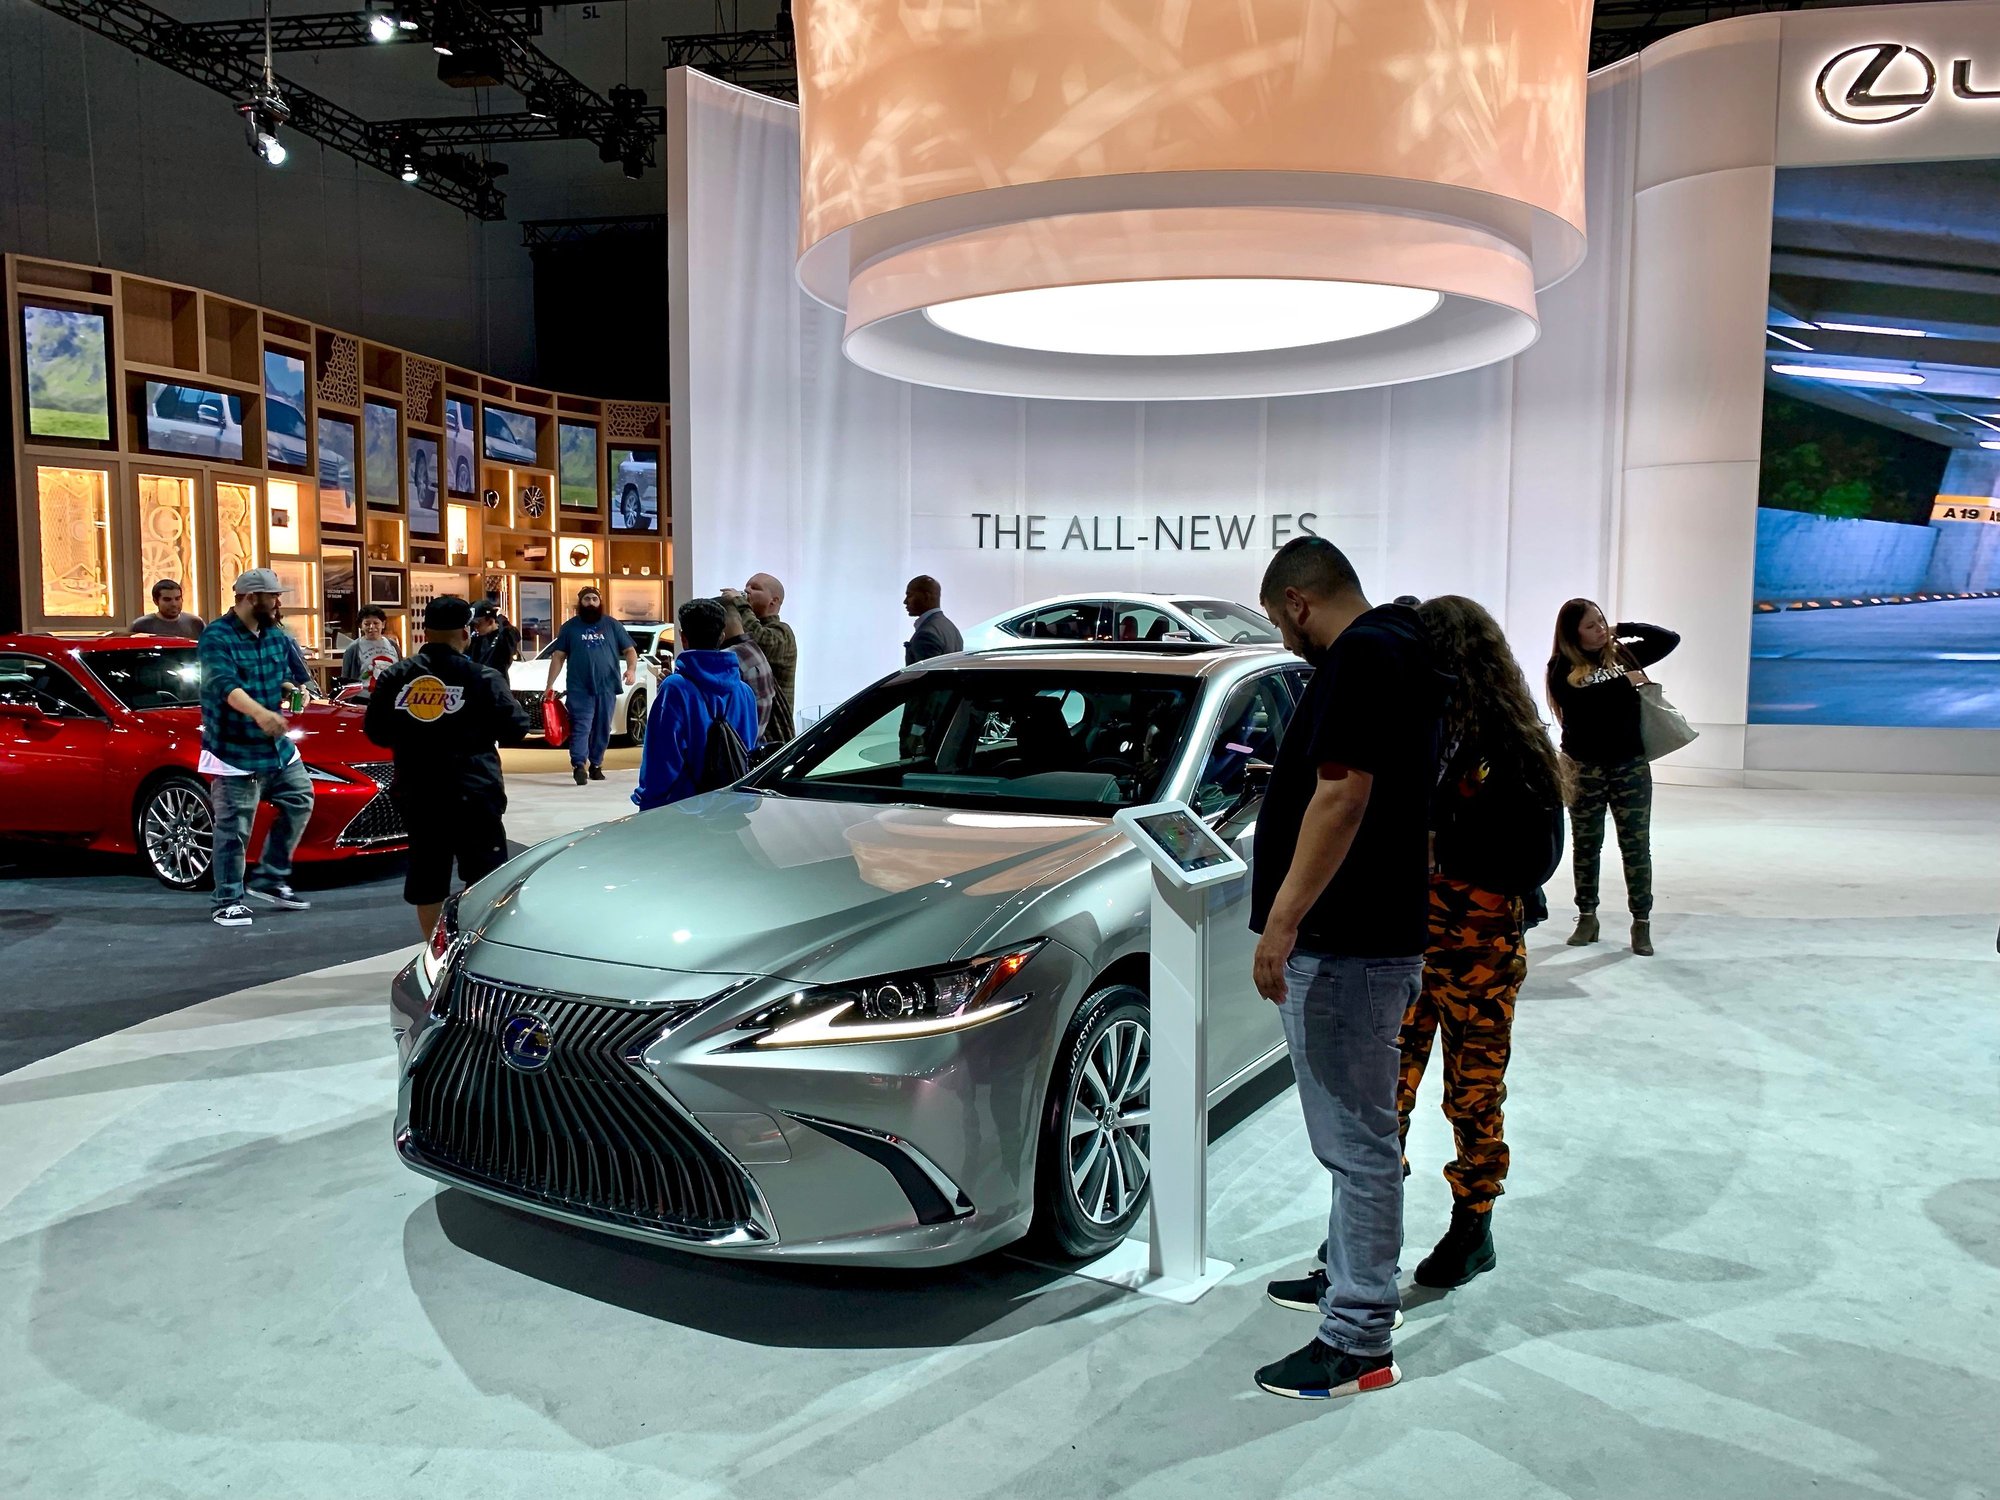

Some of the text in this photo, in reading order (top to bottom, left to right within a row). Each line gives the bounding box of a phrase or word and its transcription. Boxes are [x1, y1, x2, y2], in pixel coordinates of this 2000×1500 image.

[582, 5, 601, 20] SL
[972, 512, 1318, 552] THE ALL-NEW ES
[581, 633, 605, 641] NASA
[397, 686, 460, 712] LAKERS
